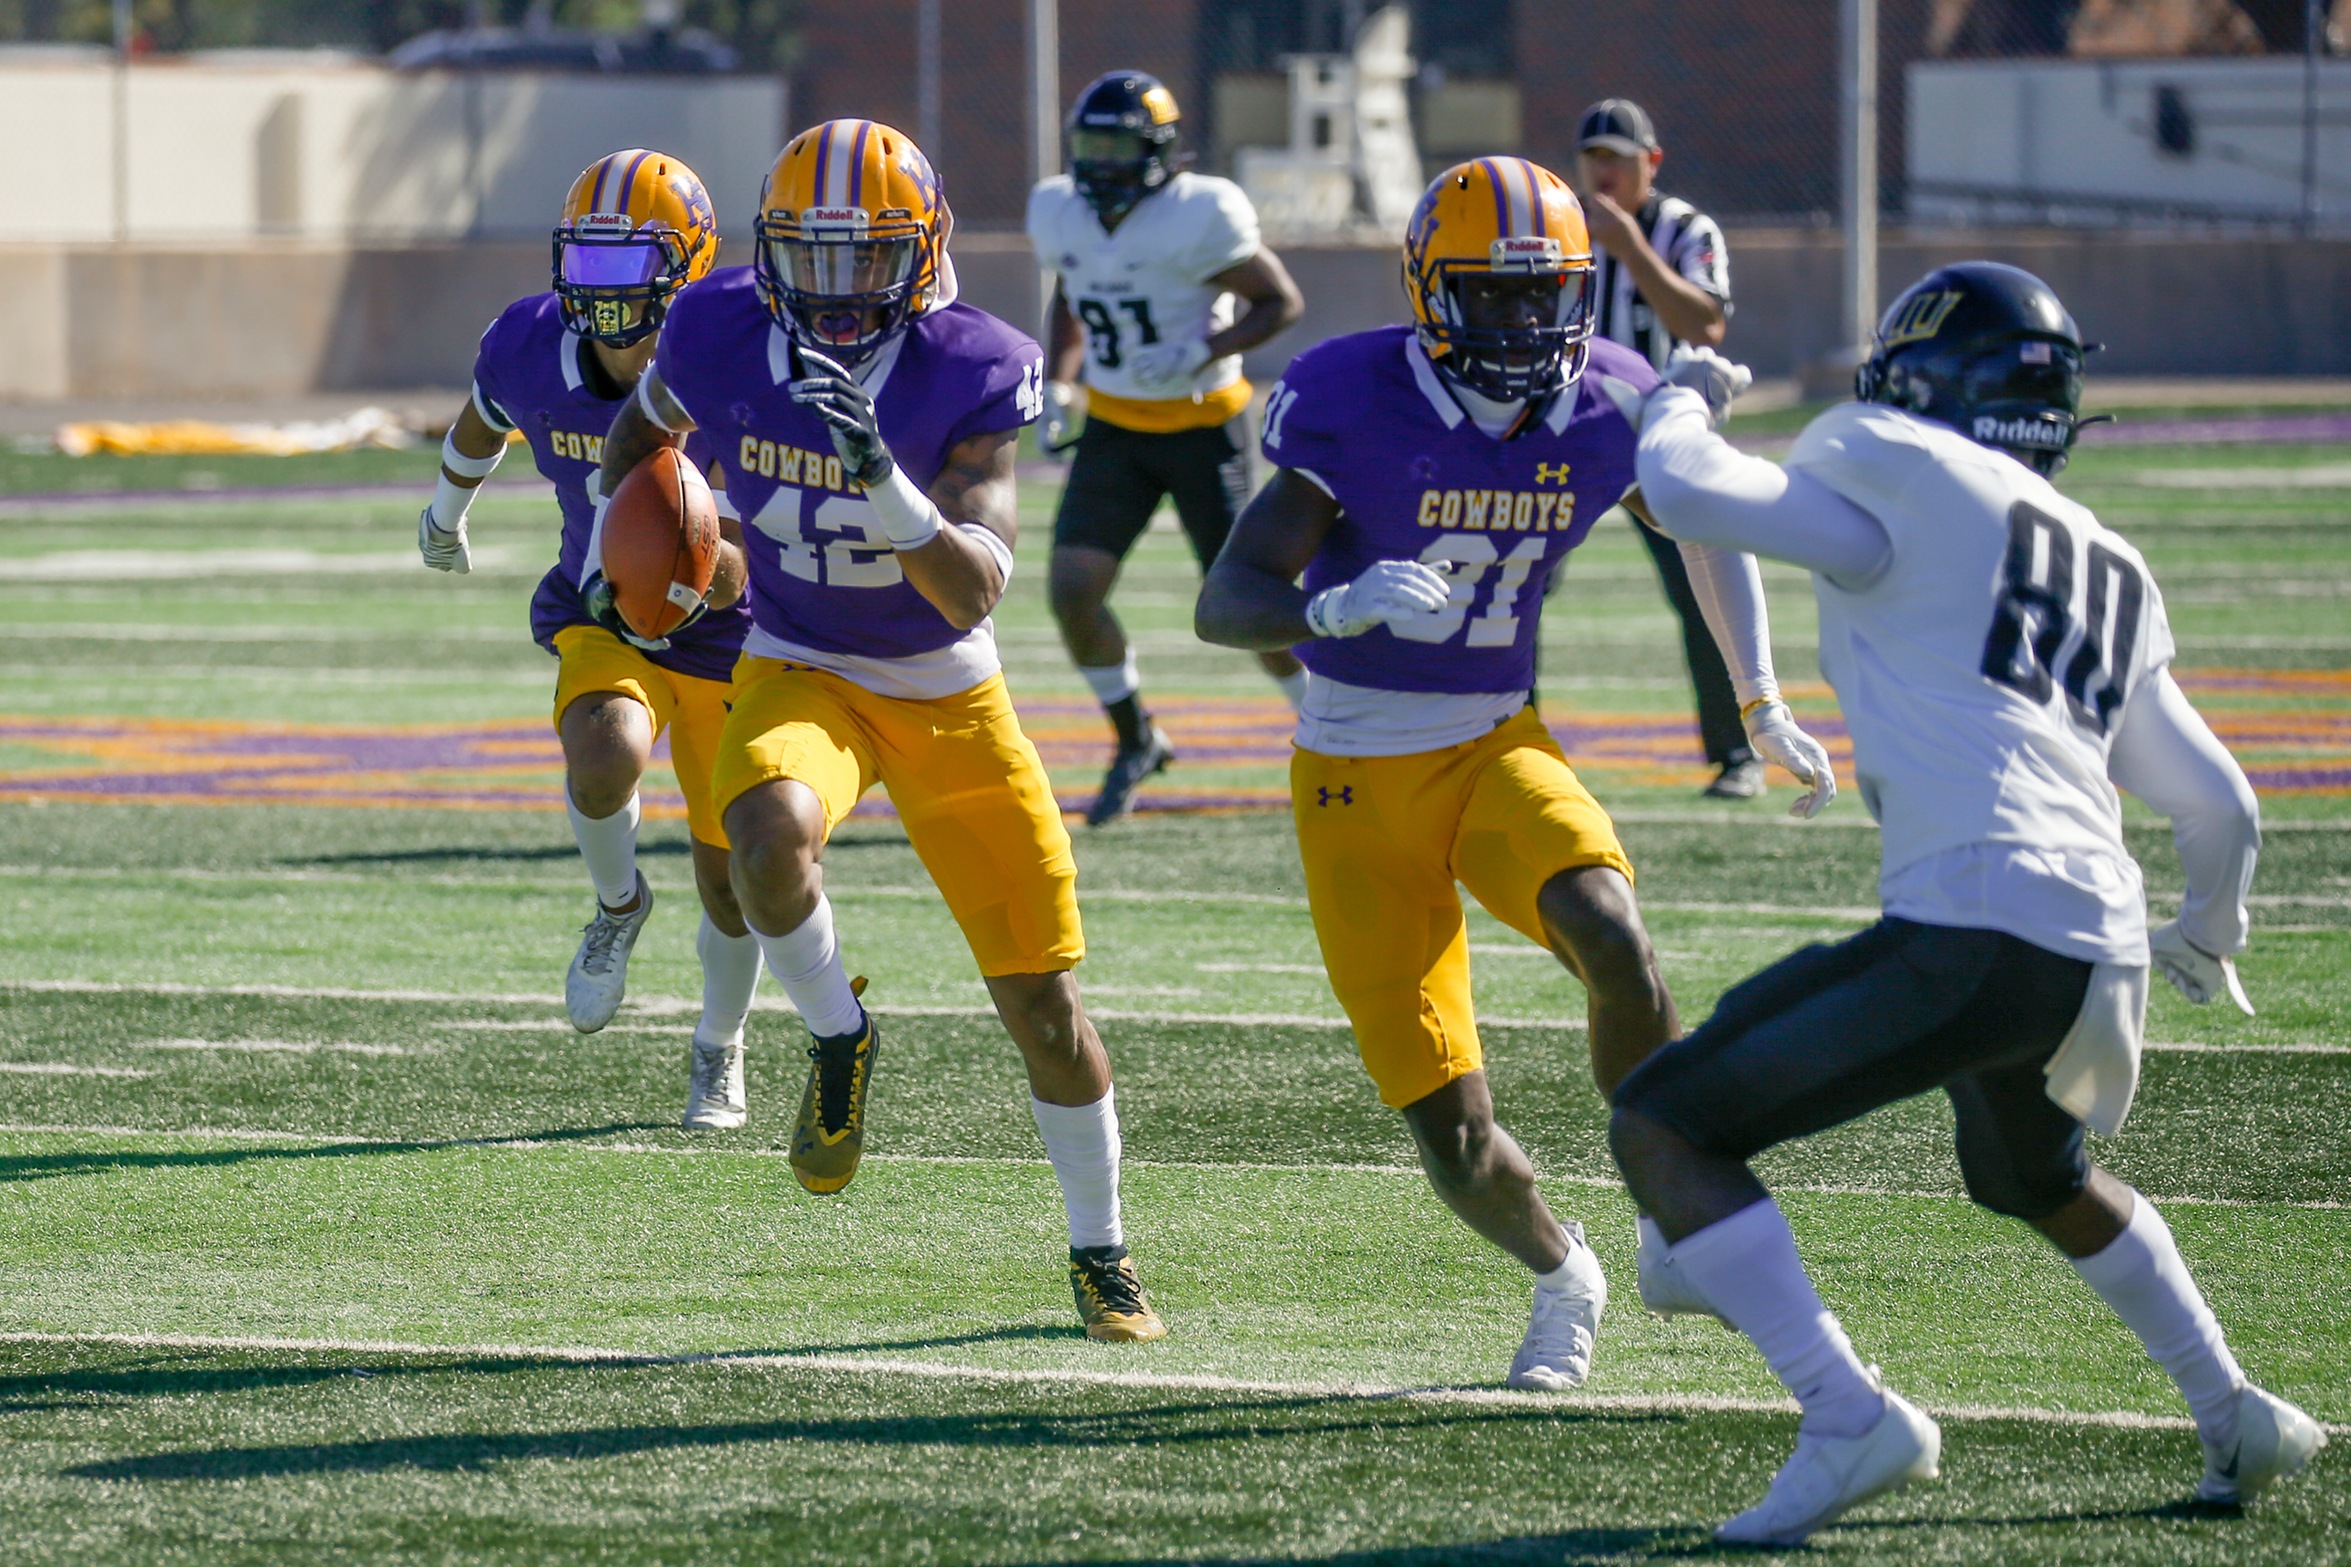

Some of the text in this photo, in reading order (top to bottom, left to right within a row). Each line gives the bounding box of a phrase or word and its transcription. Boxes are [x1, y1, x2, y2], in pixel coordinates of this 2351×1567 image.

[590, 215, 620, 225] Riddell
[815, 209, 854, 220] Riddell
[1506, 241, 1544, 251] Riddell
[1016, 356, 1044, 421] 42
[1972, 415, 2069, 444] Riddell
[740, 435, 862, 494] COWBO
[1417, 489, 1576, 532] COWBOYS
[751, 485, 904, 588] 42
[1980, 500, 2143, 740] 80
